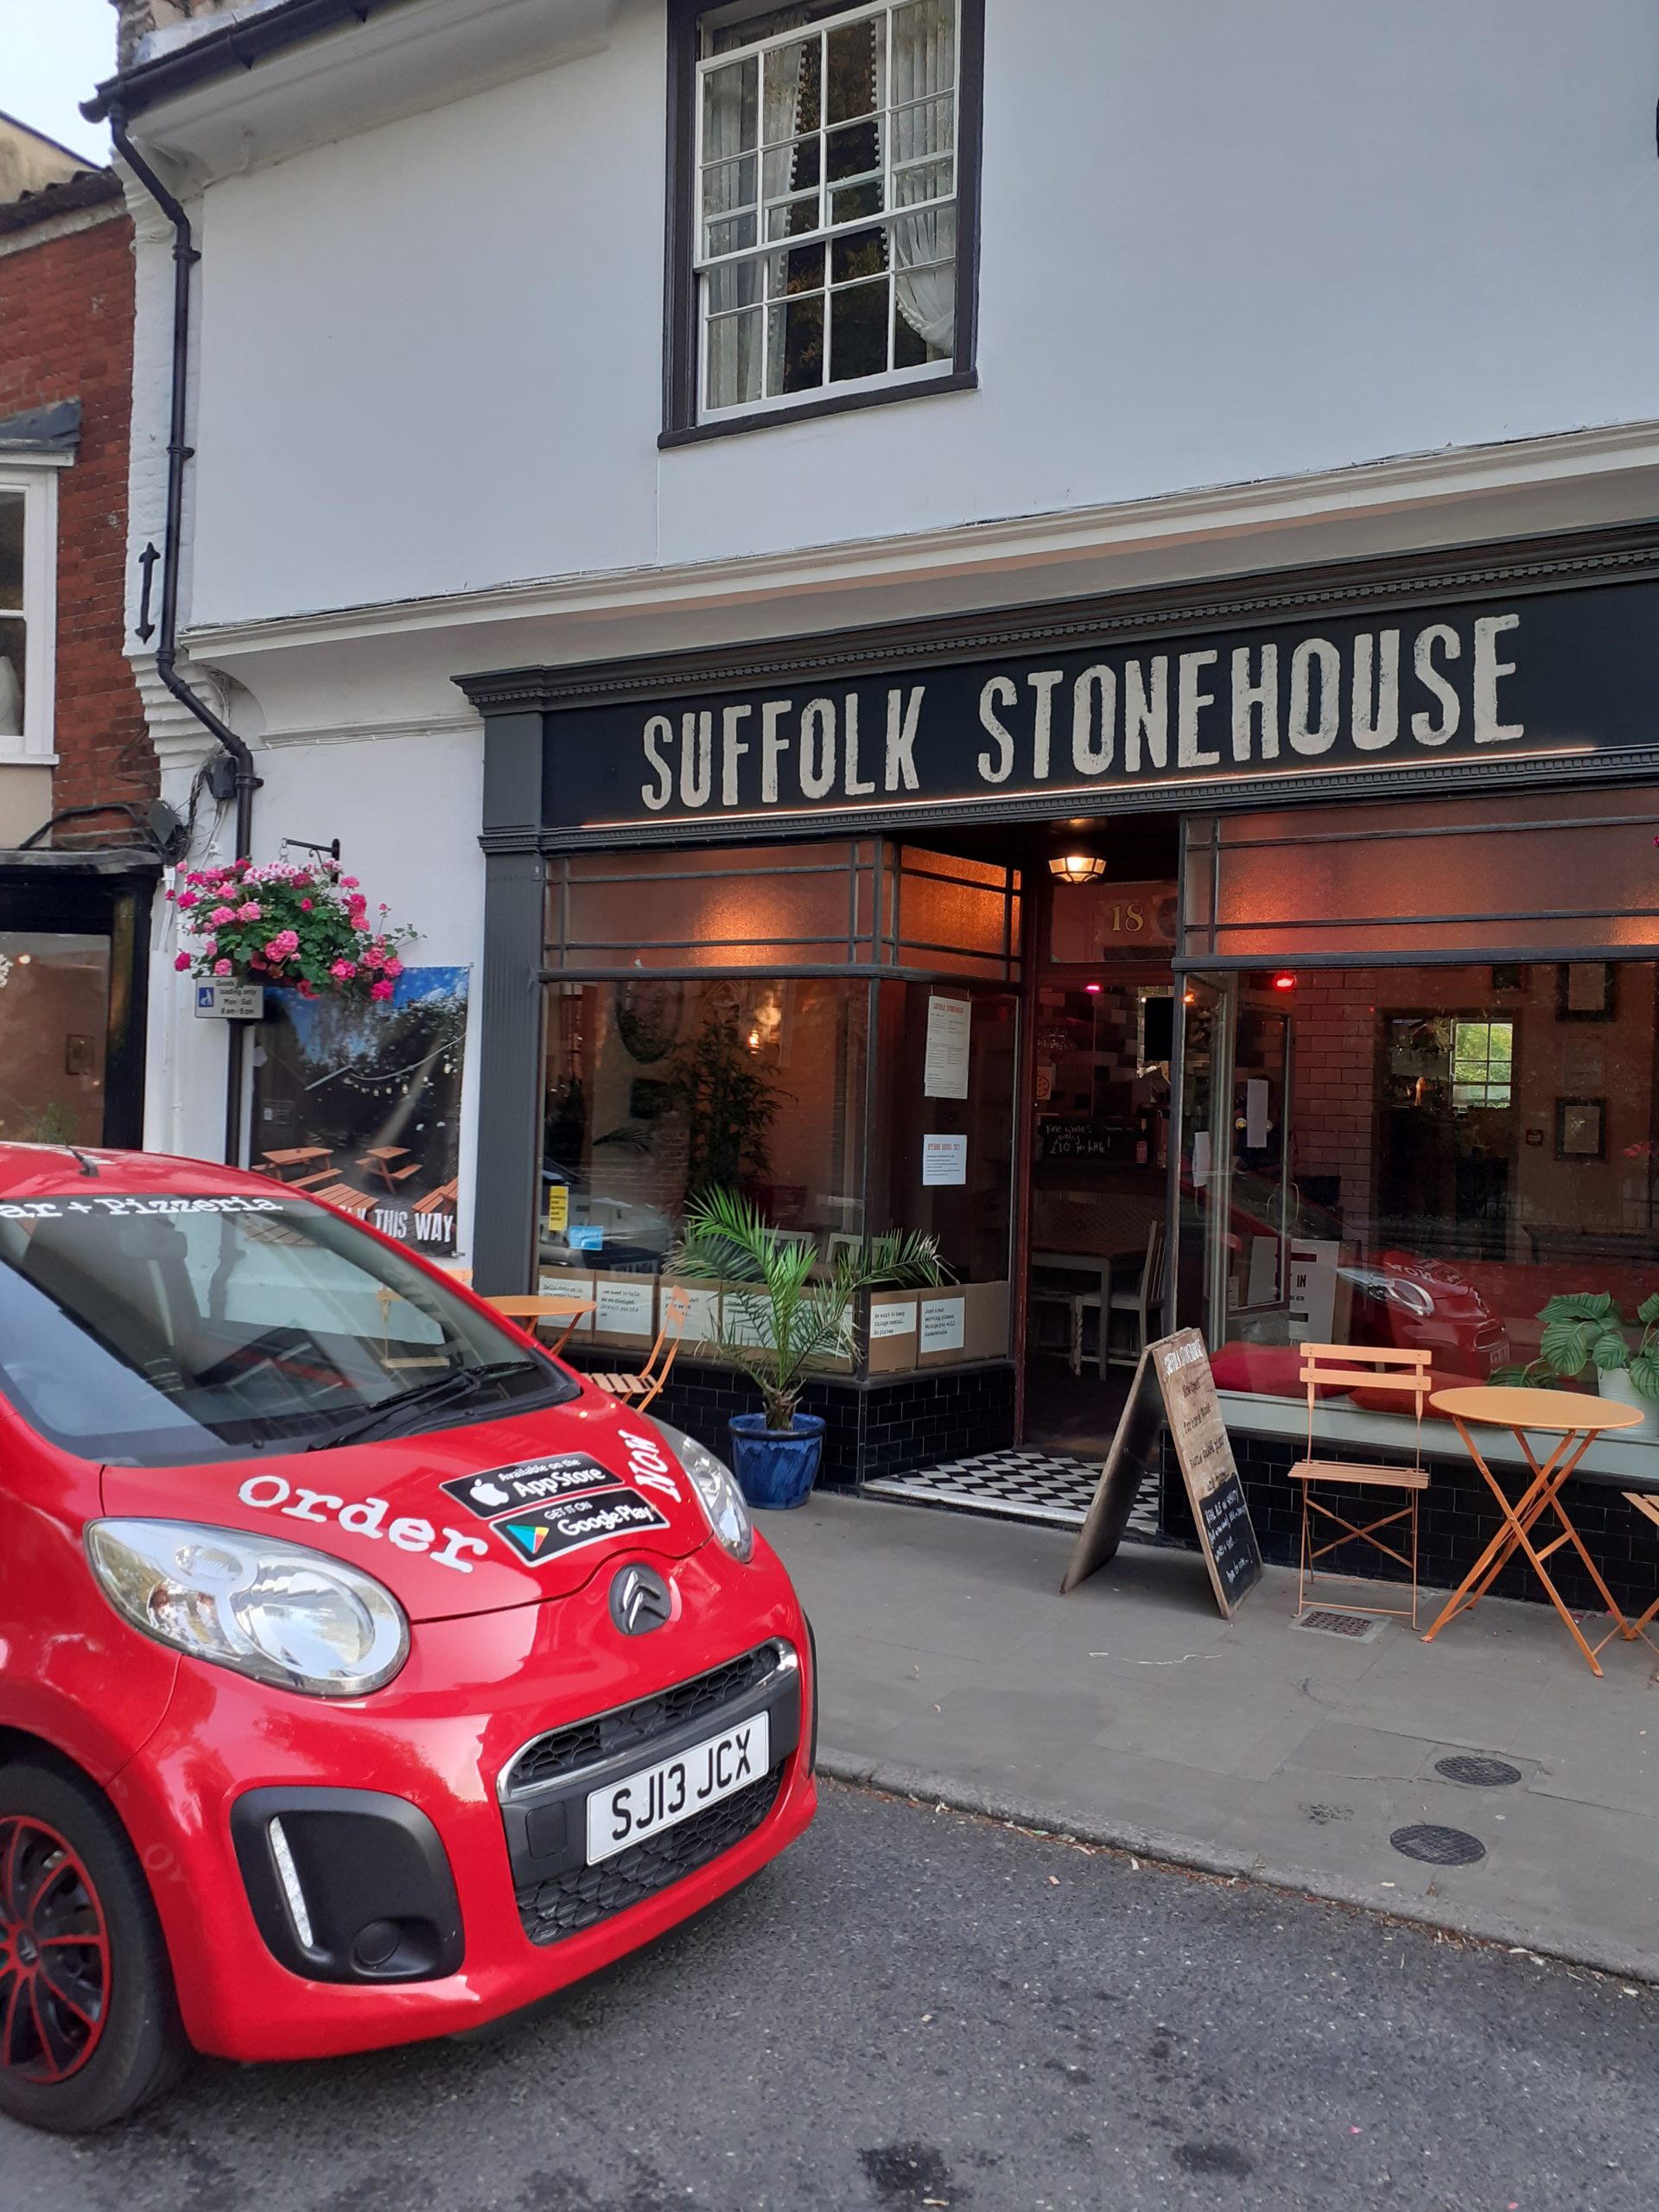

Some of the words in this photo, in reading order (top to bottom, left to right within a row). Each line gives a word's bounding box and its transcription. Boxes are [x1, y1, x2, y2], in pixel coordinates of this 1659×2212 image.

[641, 686, 925, 810] SUFFOLK
[977, 613, 1525, 784] STONEHOUSE
[1110, 904, 1143, 931] 18
[1058, 1133, 1080, 1146] only
[1065, 1124, 1093, 1134] wines
[93, 1196, 283, 1215] Pizzeria
[374, 1209, 409, 1238] THIS
[414, 1212, 454, 1243] WAY
[1296, 1274, 1306, 1287] IN
[498, 1464, 550, 1483] Available
[548, 1461, 562, 1471] on
[562, 1457, 582, 1467] the
[618, 1429, 682, 1503] NOW
[238, 1475, 488, 1573] Order
[543, 1507, 566, 1521] GET
[565, 1504, 575, 1516] IT
[575, 1500, 594, 1511] ON
[556, 1509, 625, 1536] Google
[614, 1504, 655, 1522] Play
[612, 1762, 686, 1841] SJ13
[696, 1727, 752, 1799] JCX
